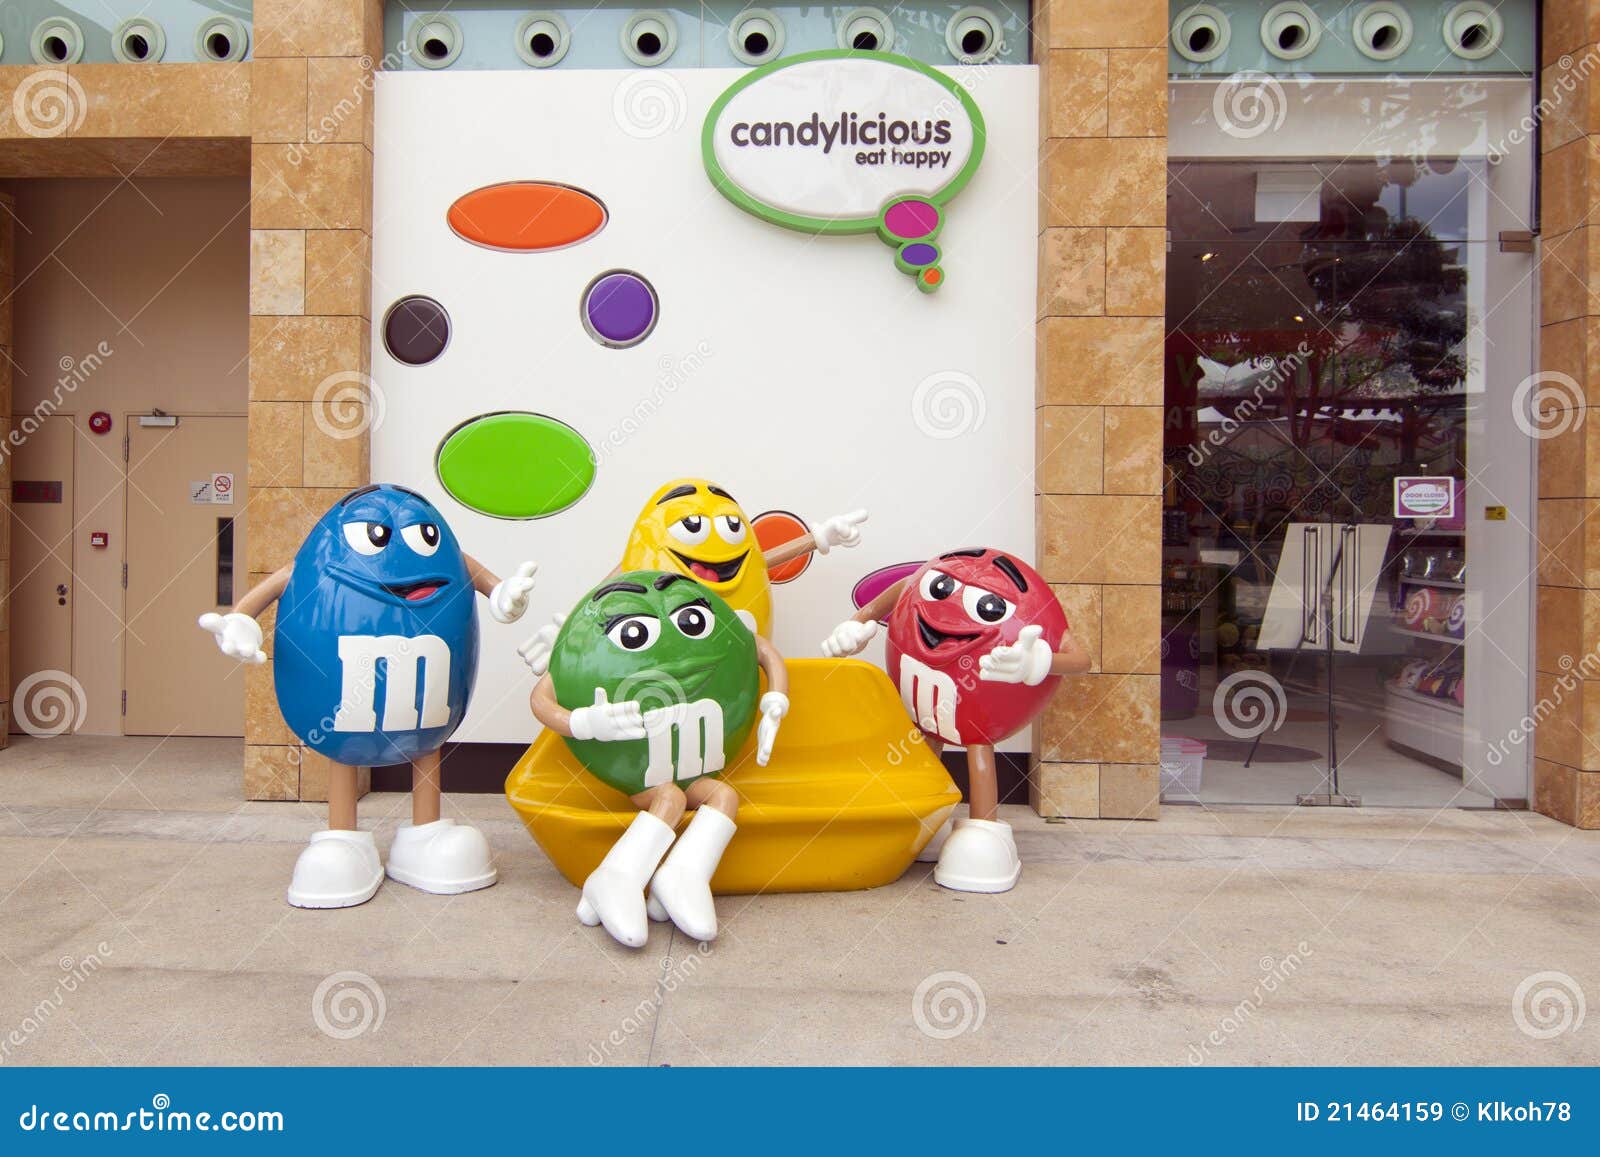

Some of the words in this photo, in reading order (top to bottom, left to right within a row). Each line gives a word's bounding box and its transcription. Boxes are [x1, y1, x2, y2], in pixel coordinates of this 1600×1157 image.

[731, 112, 951, 153] candylicious
[855, 149, 886, 165] eat
[892, 147, 951, 168] happy
[333, 634, 451, 732] m
[900, 653, 962, 745] m
[643, 698, 726, 787] m
